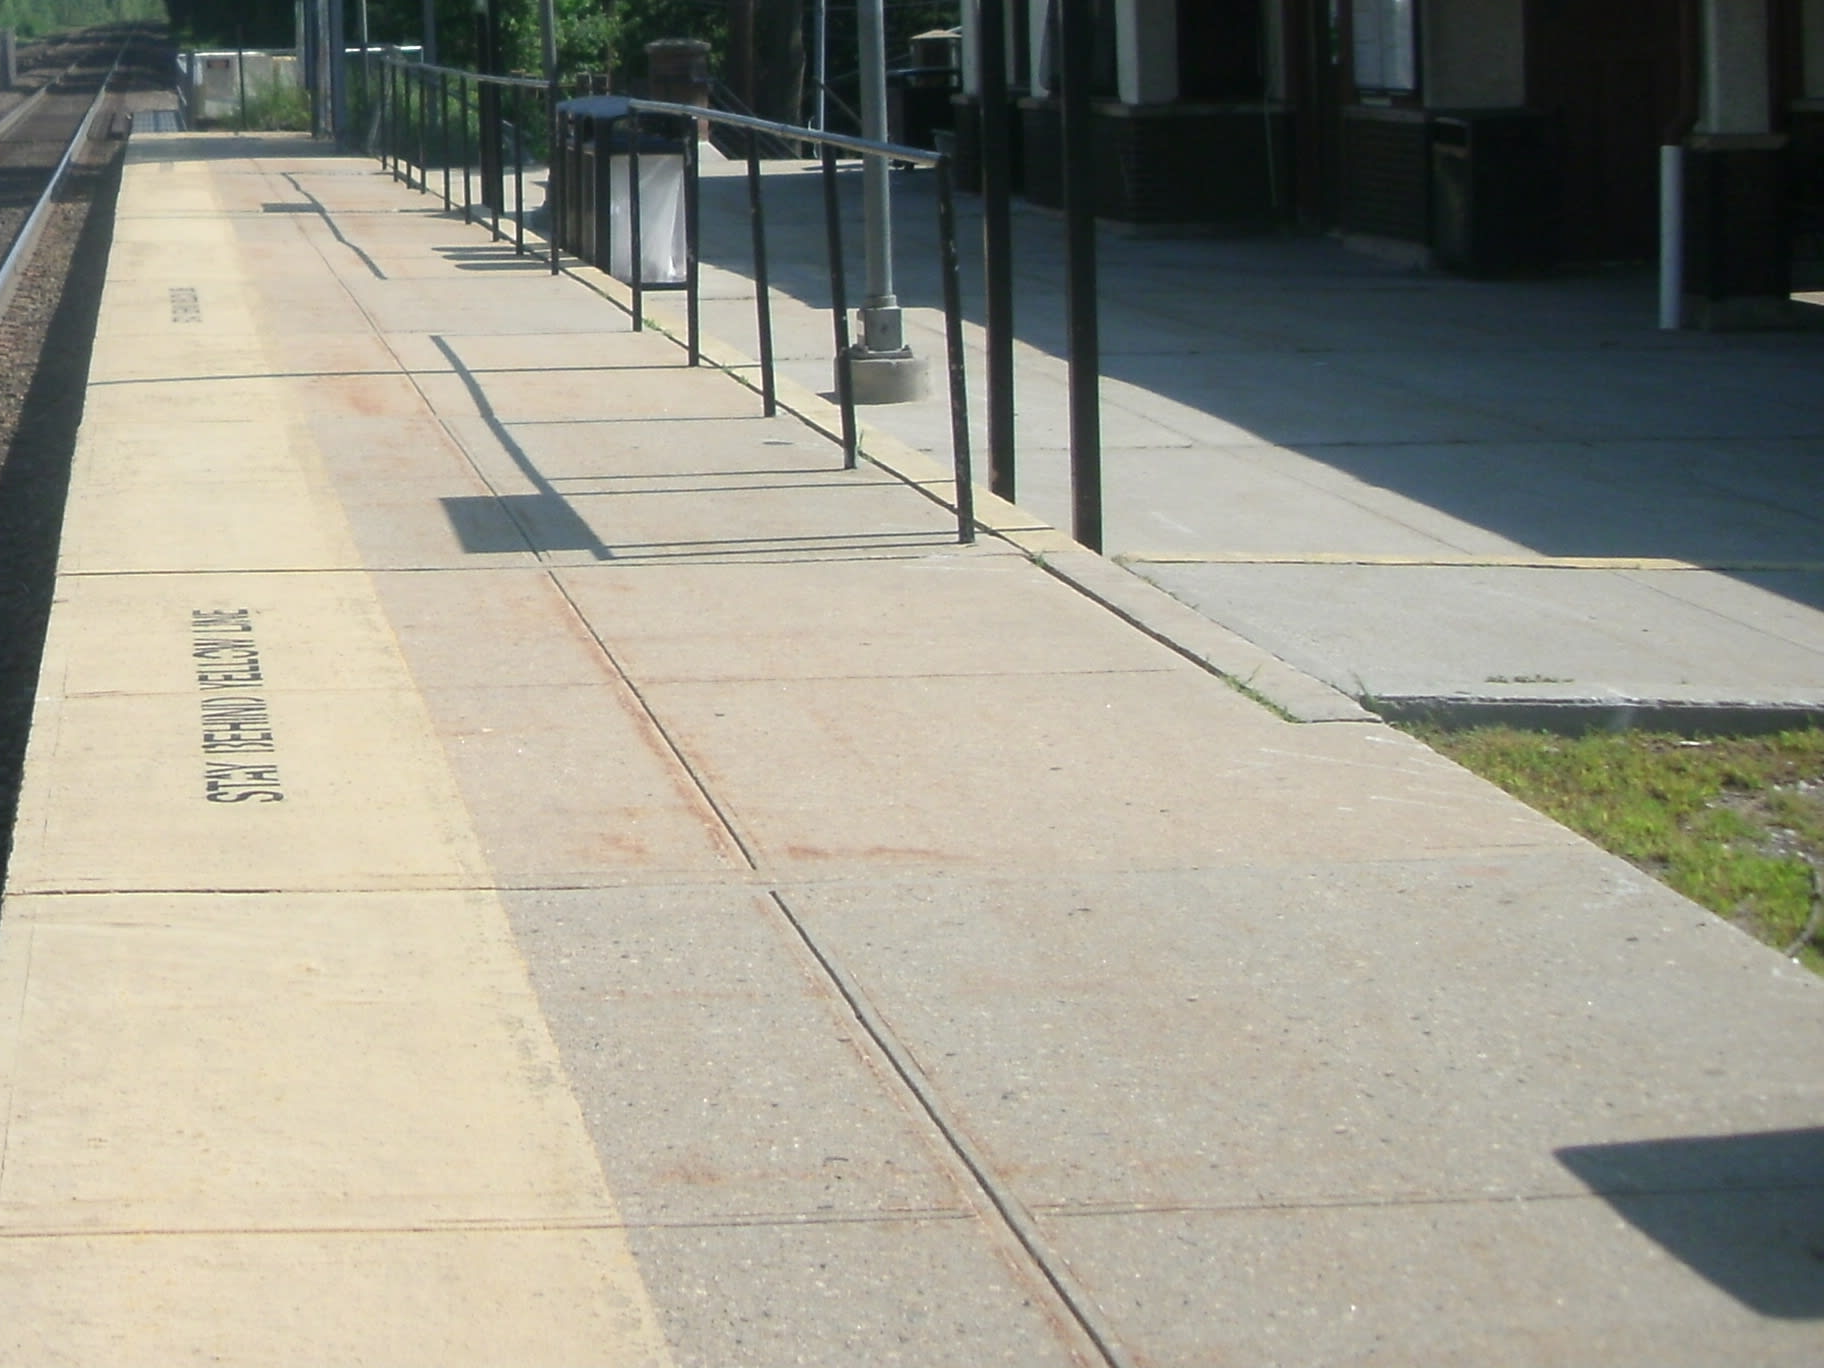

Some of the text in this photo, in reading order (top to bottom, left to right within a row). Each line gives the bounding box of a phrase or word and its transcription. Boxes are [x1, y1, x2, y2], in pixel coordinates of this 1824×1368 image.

[192, 609, 284, 803] STAY BEHIND YELLOW LINE
